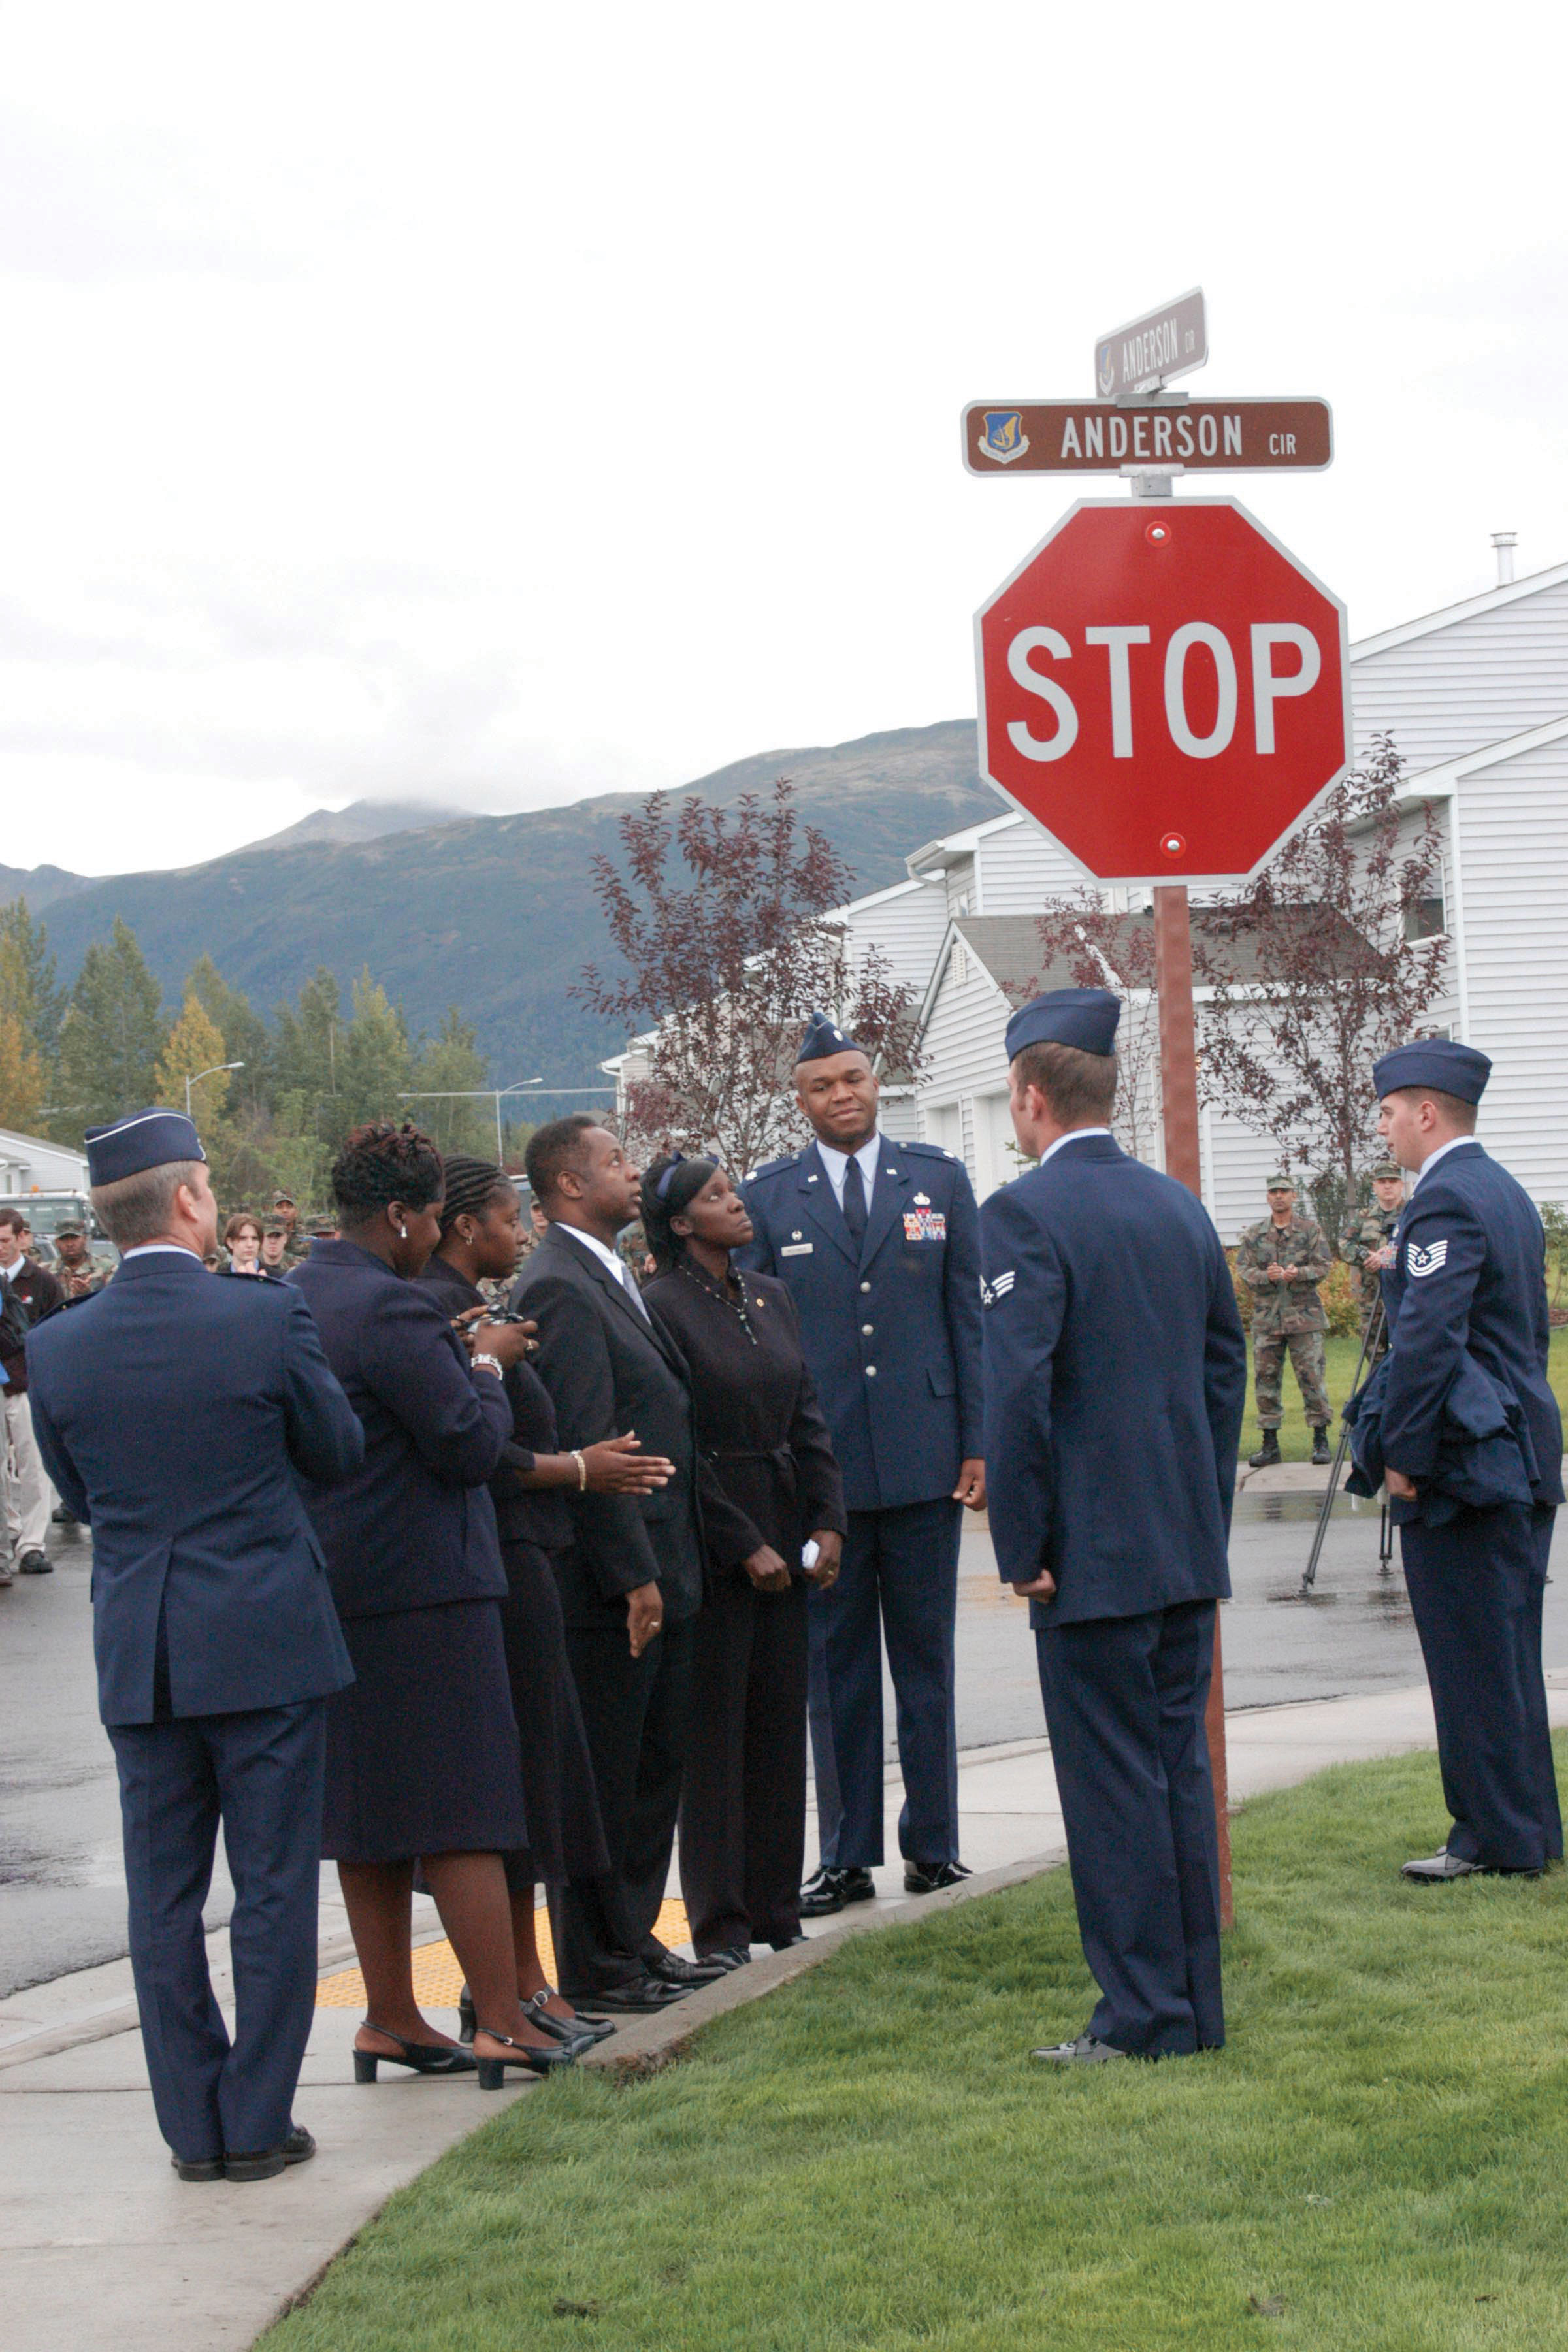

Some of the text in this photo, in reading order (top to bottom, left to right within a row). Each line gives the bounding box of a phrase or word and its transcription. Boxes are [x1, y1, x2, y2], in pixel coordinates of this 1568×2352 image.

[1122, 318, 1178, 384] ANDERSON
[1060, 415, 1242, 458] ANDERSON
[1269, 433, 1296, 455] CIR
[1007, 621, 1322, 762] STOP
